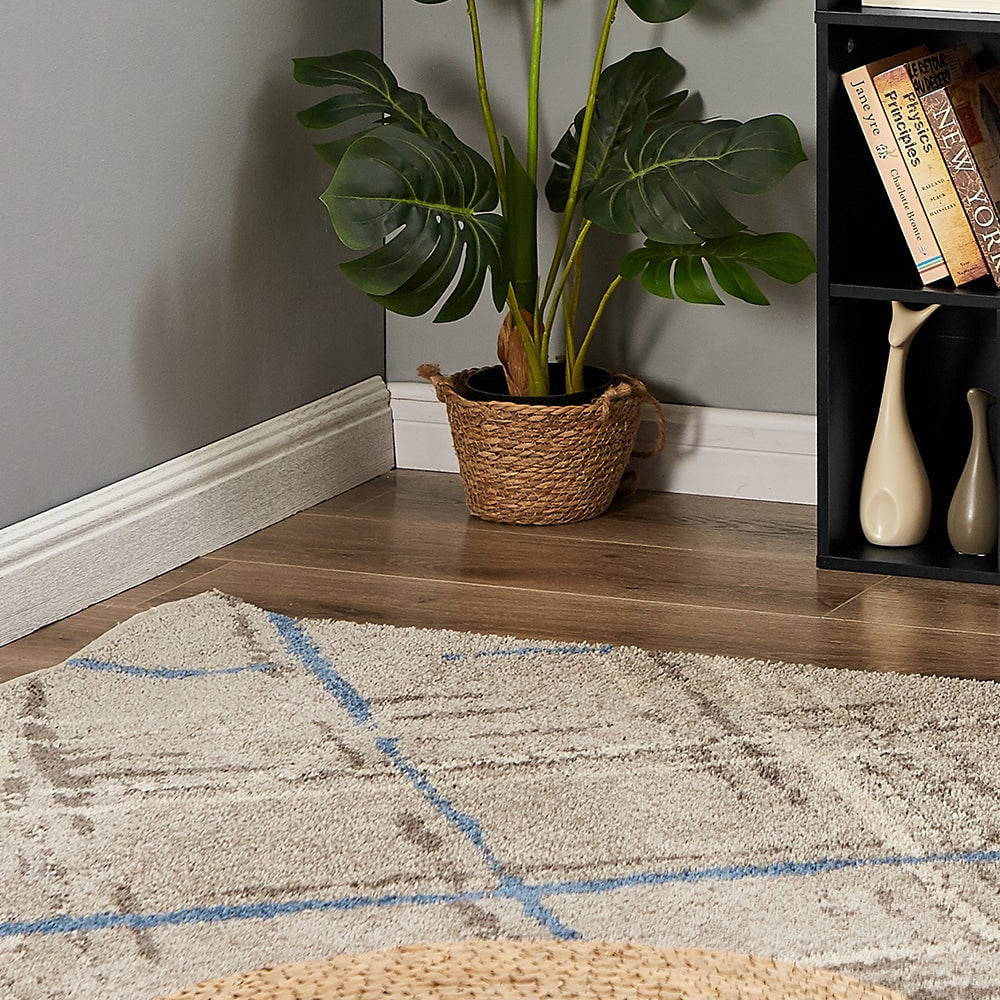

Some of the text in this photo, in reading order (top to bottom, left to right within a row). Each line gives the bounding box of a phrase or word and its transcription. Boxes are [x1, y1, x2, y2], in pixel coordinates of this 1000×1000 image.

[851, 80, 881, 136] Jane yre
[884, 90, 921, 168] Principles
[903, 91, 934, 154] Physics
[934, 106, 976, 173] NEW
[889, 167, 923, 242] Charlotte Bronte
